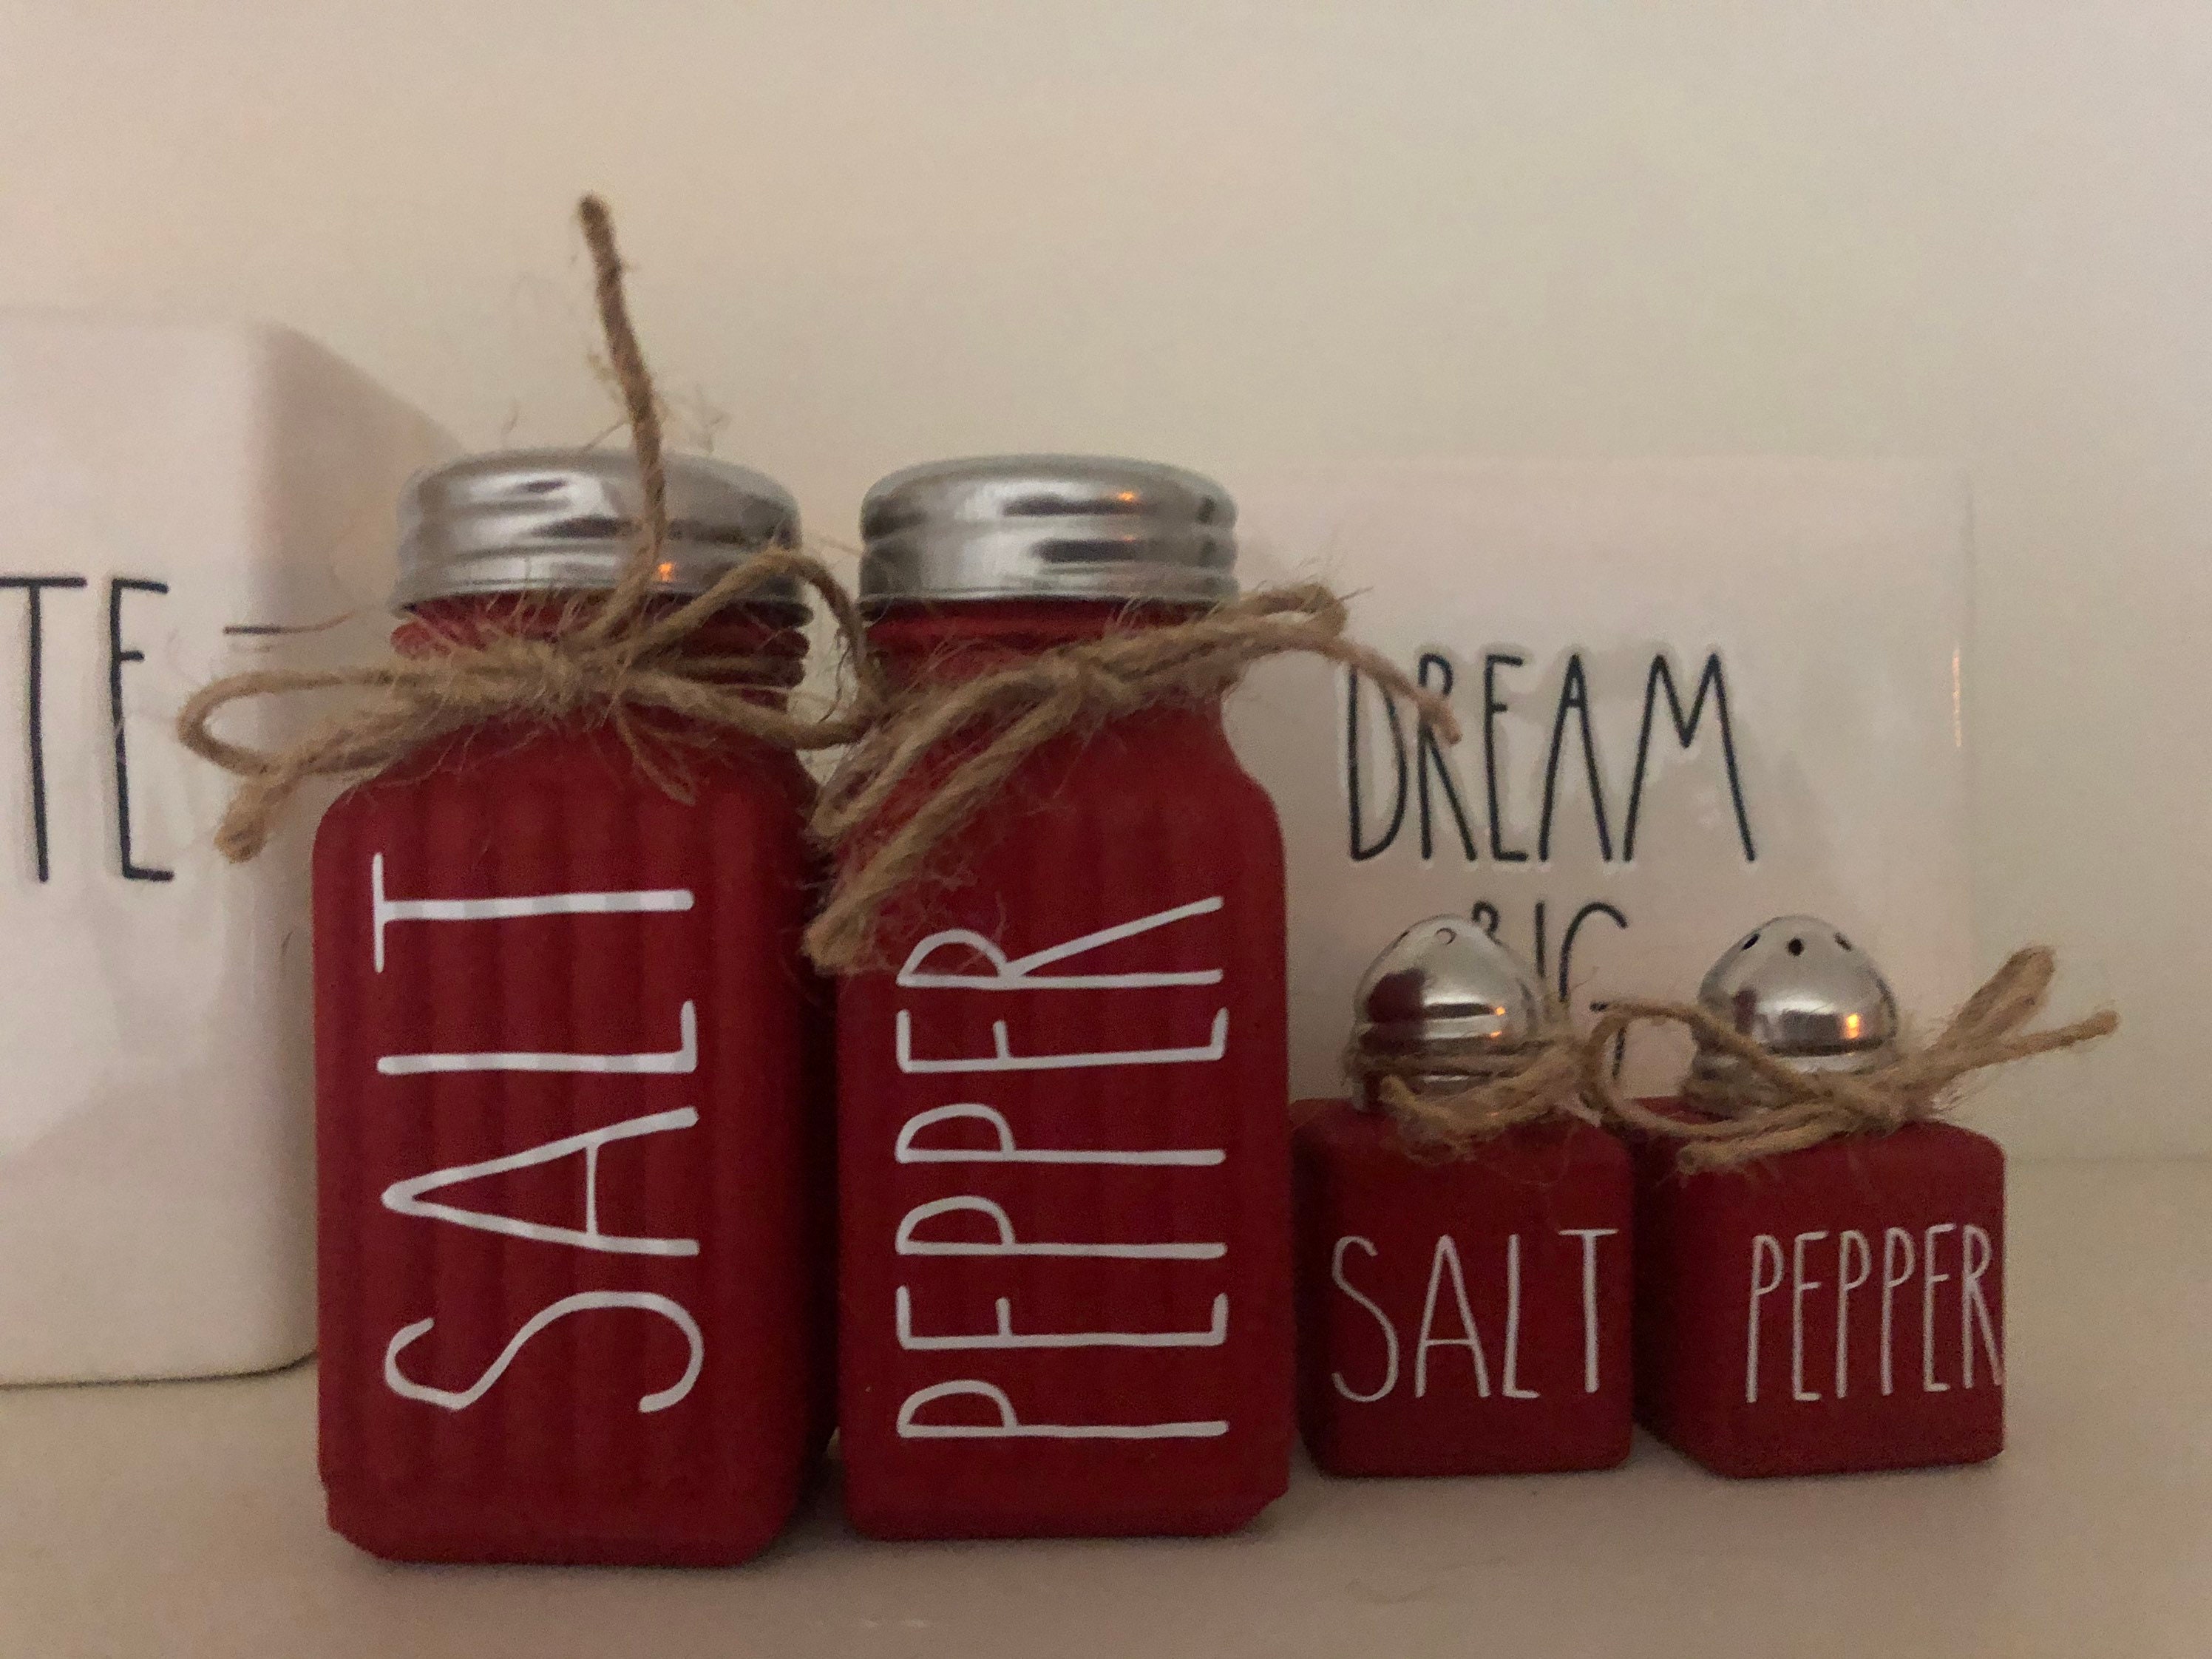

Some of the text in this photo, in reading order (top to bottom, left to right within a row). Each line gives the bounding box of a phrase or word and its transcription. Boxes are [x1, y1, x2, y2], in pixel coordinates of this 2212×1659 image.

[1343, 651, 1756, 863] DREAM
[371, 851, 703, 1414] SALT
[895, 895, 1229, 1439] PEPPER
[1331, 1228, 1619, 1402] SALT
[1745, 1222, 2003, 1403] PEPPER
